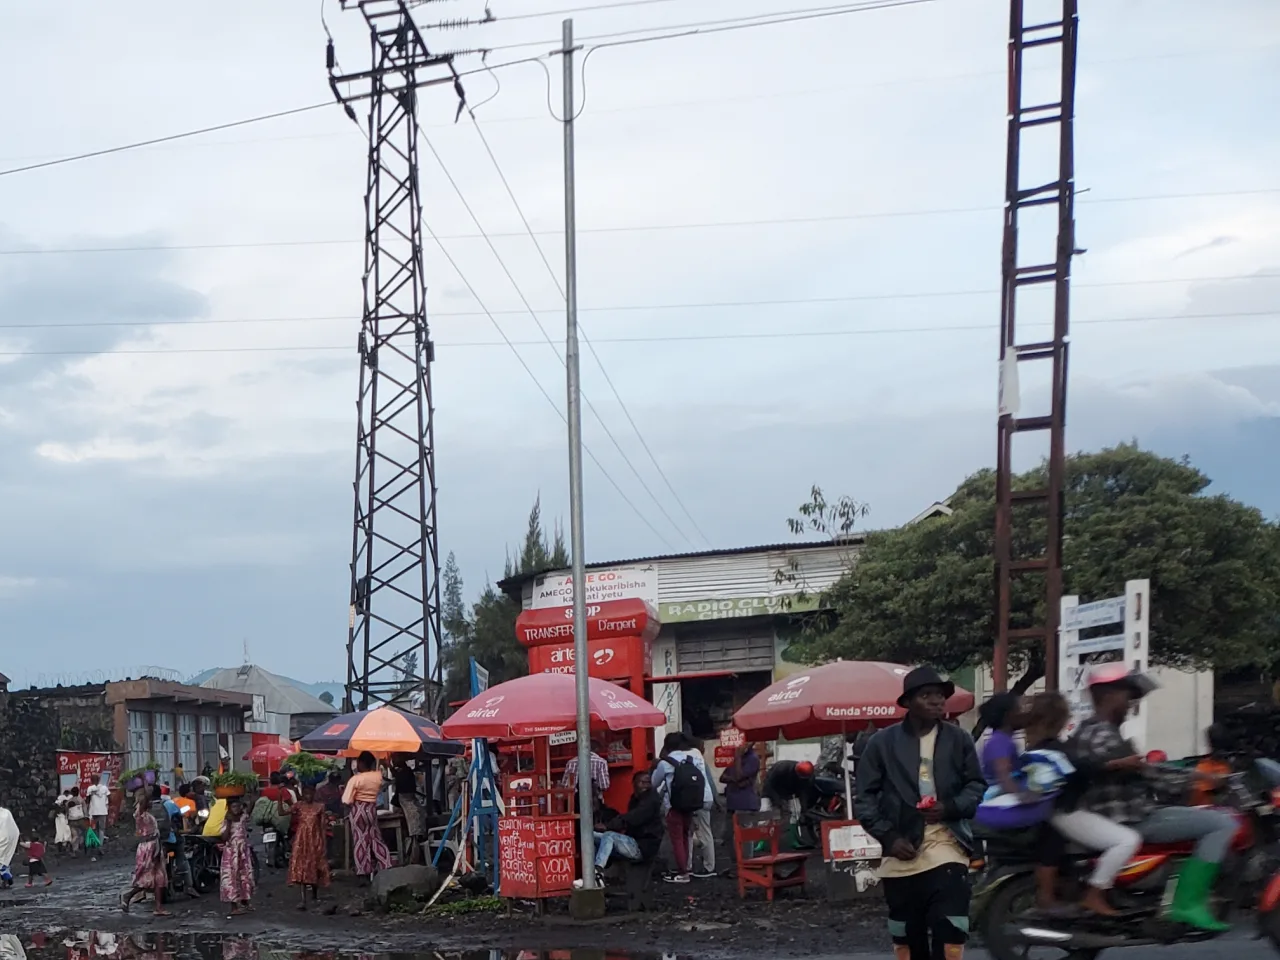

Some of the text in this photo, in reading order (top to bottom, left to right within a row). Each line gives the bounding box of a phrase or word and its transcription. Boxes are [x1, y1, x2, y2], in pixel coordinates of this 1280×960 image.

[598, 573, 616, 581] GO
[540, 587, 572, 599] AMEGO
[565, 605, 601, 619] SOP
[668, 601, 734, 616] RADIO
[551, 648, 576, 662] airte
[664, 649, 675, 723] PHAMACIE
[767, 688, 803, 702] airtel
[607, 700, 637, 709] airtel
[826, 707, 860, 716] Kanda
[467, 708, 500, 718] airtel
[542, 859, 571, 873] VODA
